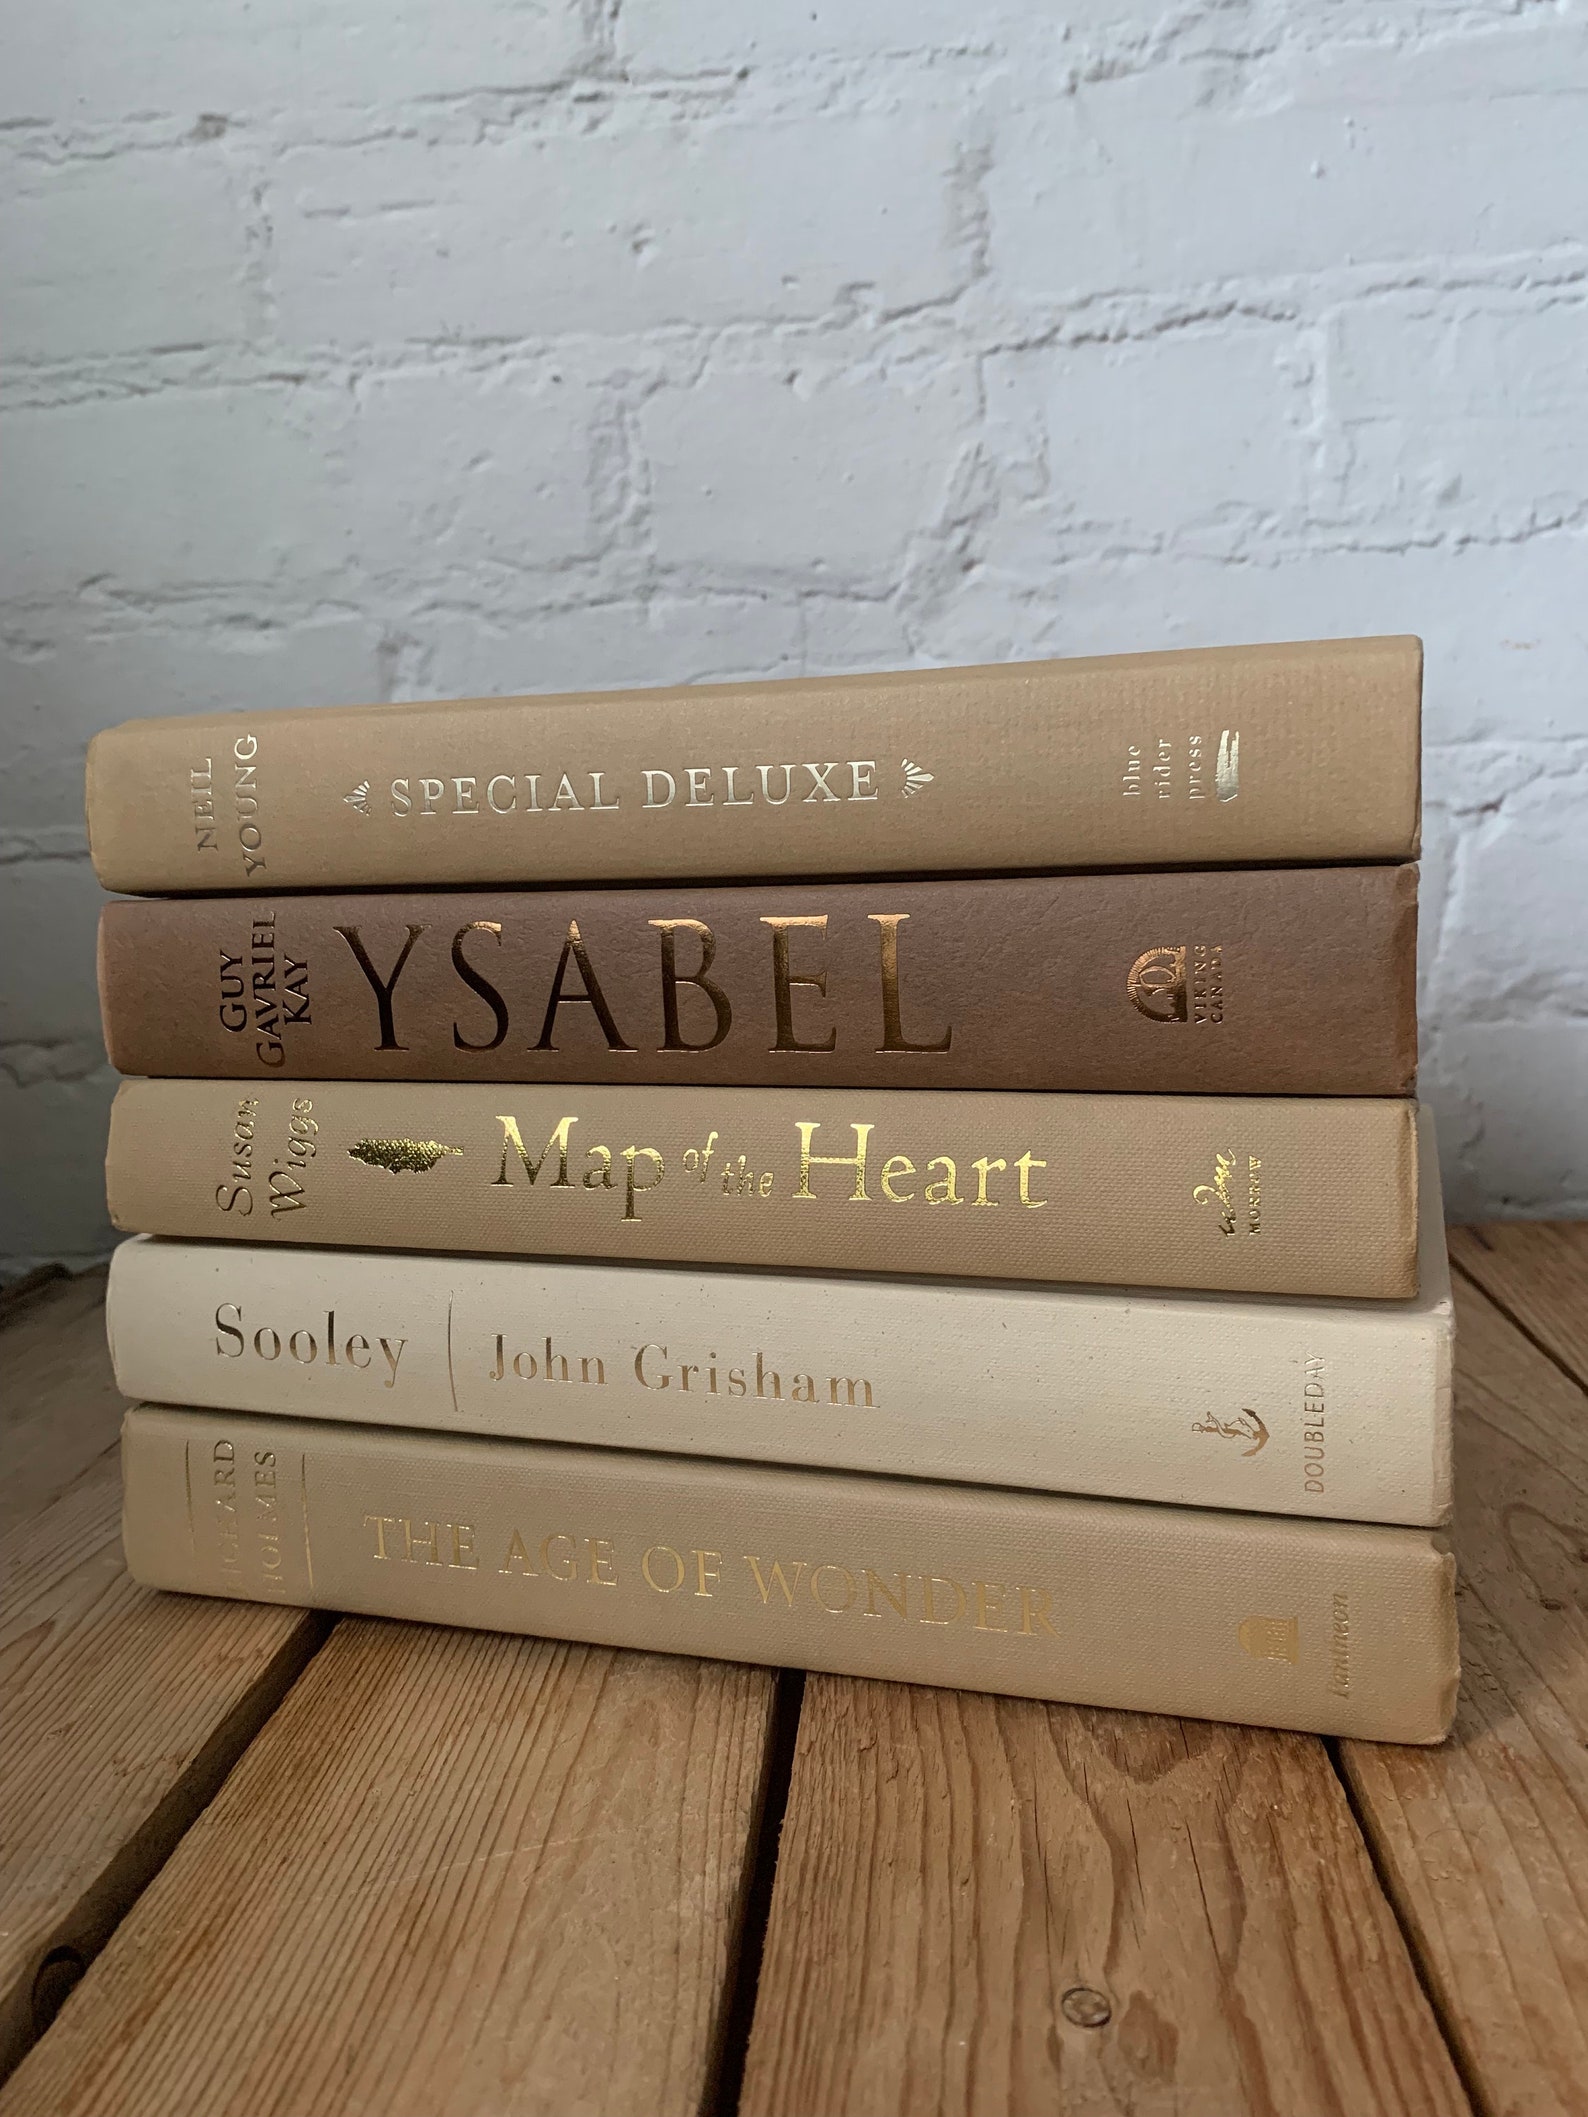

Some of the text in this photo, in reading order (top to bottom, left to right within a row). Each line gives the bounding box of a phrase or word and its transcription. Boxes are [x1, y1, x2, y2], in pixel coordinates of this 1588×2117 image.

[190, 757, 219, 852] NEIL
[234, 733, 267, 876] YOUNG
[390, 758, 880, 818] SPECIAL DELUXE
[1122, 745, 1141, 796] blue
[1152, 738, 1172, 799] rider
[1188, 735, 1205, 799] press
[219, 949, 247, 1032] GUY
[252, 911, 286, 1069] GAVRIEL
[282, 956, 313, 1025] KAY
[333, 914, 953, 1055] YSABEL
[1194, 945, 1207, 1024] VIKING
[1210, 945, 1223, 1024] CANADA
[215, 1096, 259, 1217] Susan
[268, 1096, 319, 1221] Wiggs
[490, 1115, 1049, 1222] Map of the Heart
[1248, 1155, 1262, 1236] MORROW
[214, 1303, 409, 1388] Sooley
[489, 1333, 880, 1409] John Grisham
[1304, 1351, 1325, 1494] DOUBLEDAY
[362, 1514, 1062, 1640] THE AGE OF WONDER
